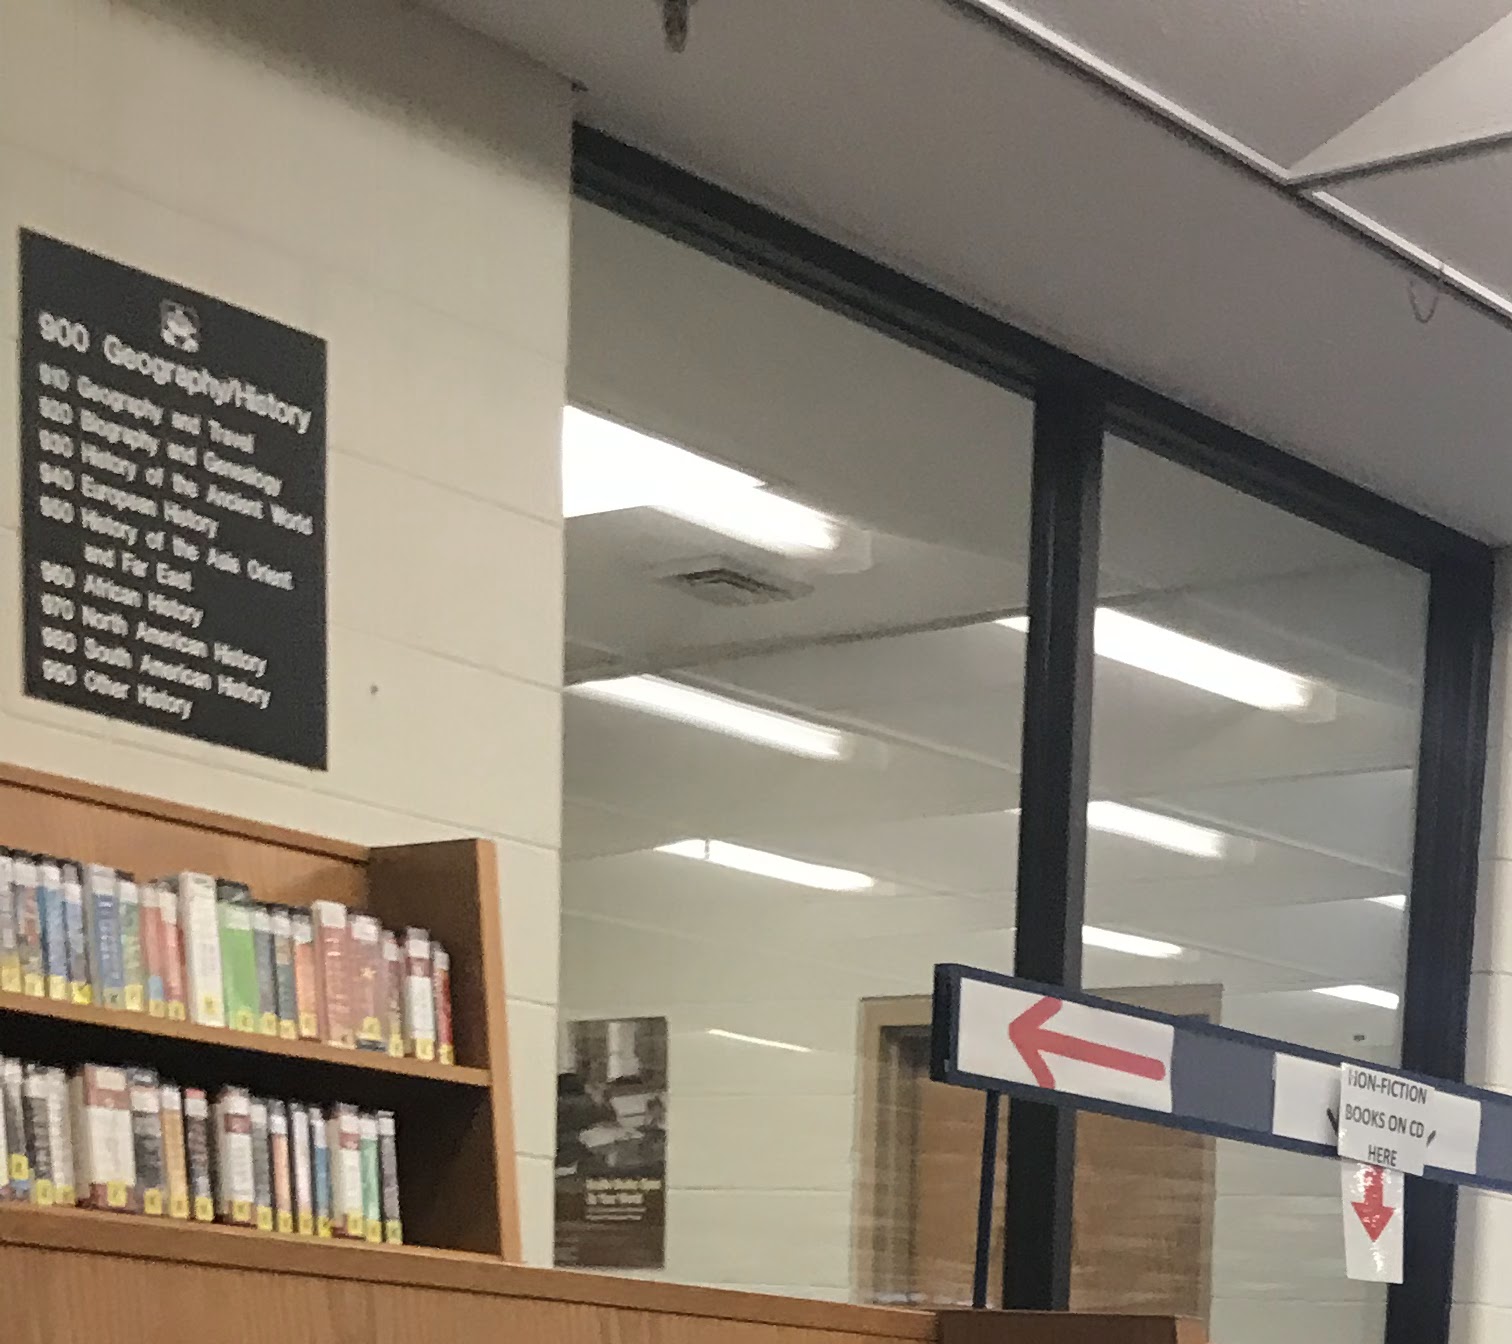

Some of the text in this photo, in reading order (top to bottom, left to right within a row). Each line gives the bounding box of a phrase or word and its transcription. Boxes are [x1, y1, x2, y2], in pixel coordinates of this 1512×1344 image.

[39, 310, 311, 435] 900 Geography/History
[77, 375, 164, 426] Geography
[81, 441, 137, 482] History
[81, 473, 158, 517] European
[164, 500, 219, 539] History
[81, 507, 138, 546] History
[121, 552, 149, 577] Far
[156, 562, 194, 592] East
[148, 591, 204, 628] History
[82, 605, 129, 637] North
[135, 621, 209, 658] American
[214, 642, 268, 678] History
[137, 684, 193, 720] History
[140, 655, 212, 690] American
[217, 674, 272, 710] History
[1348, 1069, 1428, 1105] NON-FICTION
[1345, 1103, 1425, 1139] BOOKS ON CD
[1368, 1144, 1398, 1167] HERE
